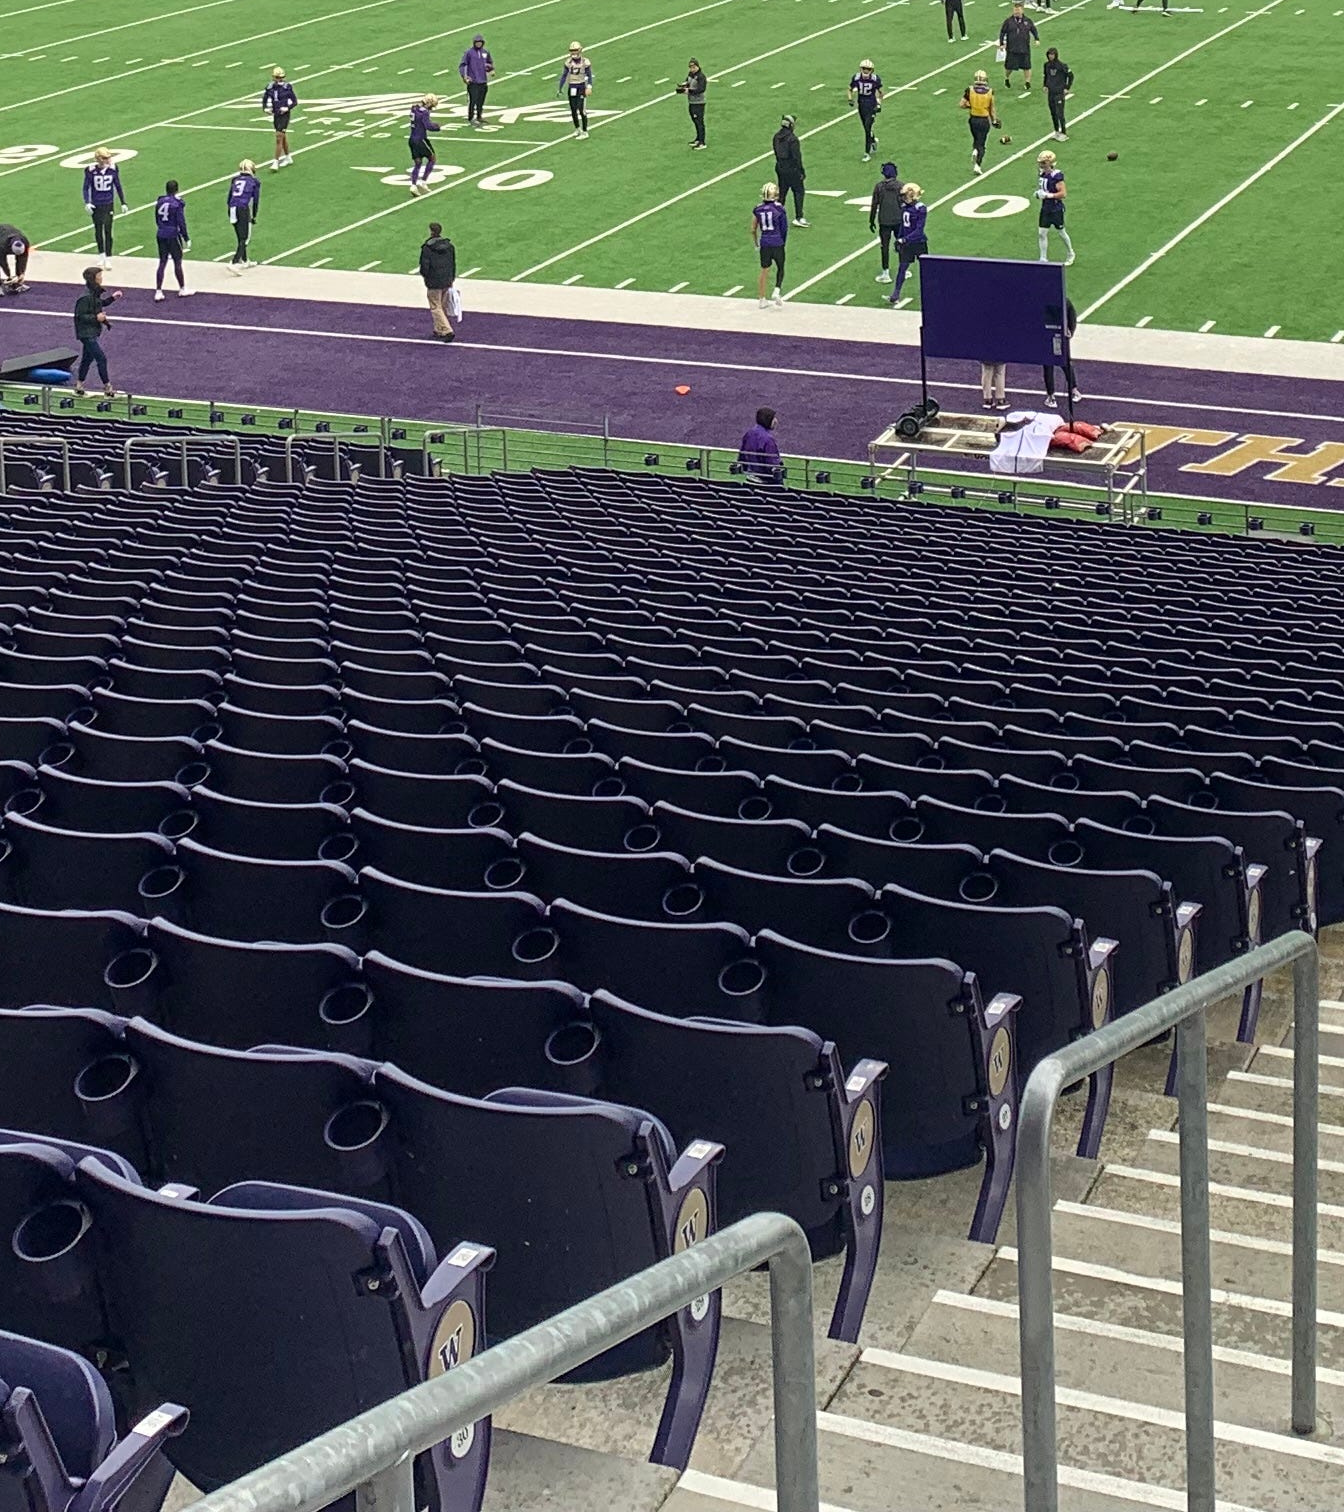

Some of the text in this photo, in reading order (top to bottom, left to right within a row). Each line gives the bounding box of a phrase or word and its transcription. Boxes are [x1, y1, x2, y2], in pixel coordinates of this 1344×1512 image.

[857, 81, 873, 97] 12
[93, 174, 113, 192] 82
[232, 181, 246, 197] 3
[157, 202, 170, 222] 4
[759, 211, 774, 232] 11
[853, 1118, 869, 1154] W
[680, 1208, 700, 1250] W
[437, 1324, 463, 1372] W
